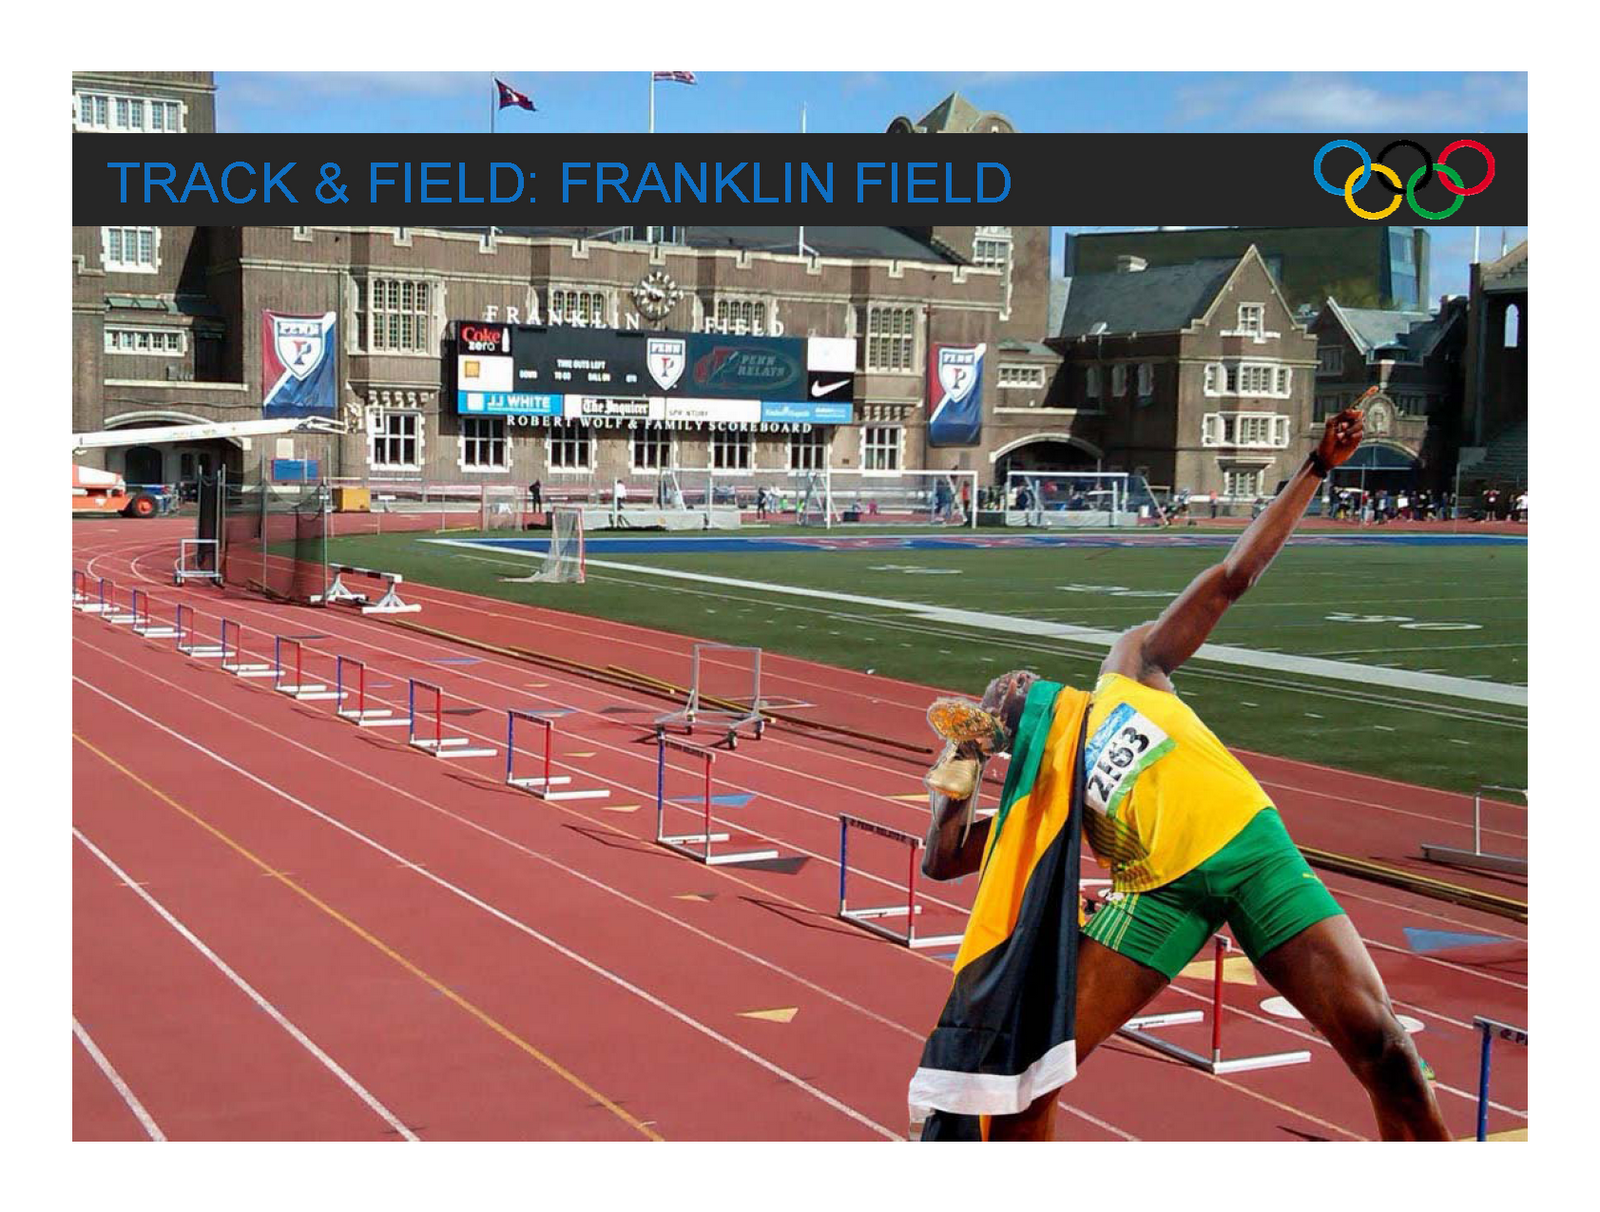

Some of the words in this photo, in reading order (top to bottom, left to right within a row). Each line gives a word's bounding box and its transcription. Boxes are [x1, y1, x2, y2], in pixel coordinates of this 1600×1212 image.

[485, 305, 641, 330] FRANKLIN
[704, 317, 785, 337] FIELD
[462, 326, 500, 344] Coke
[468, 341, 495, 351] zero
[651, 343, 682, 354] PENN
[741, 354, 776, 365] PENN
[487, 394, 503, 406] JJ
[506, 395, 549, 408] WHITE
[582, 398, 604, 414] The
[506, 415, 572, 428] ROBERT
[580, 417, 623, 429] WOLF
[627, 418, 638, 429] &
[645, 418, 703, 432] FAMILY
[708, 421, 812, 434] SCOREBOARD
